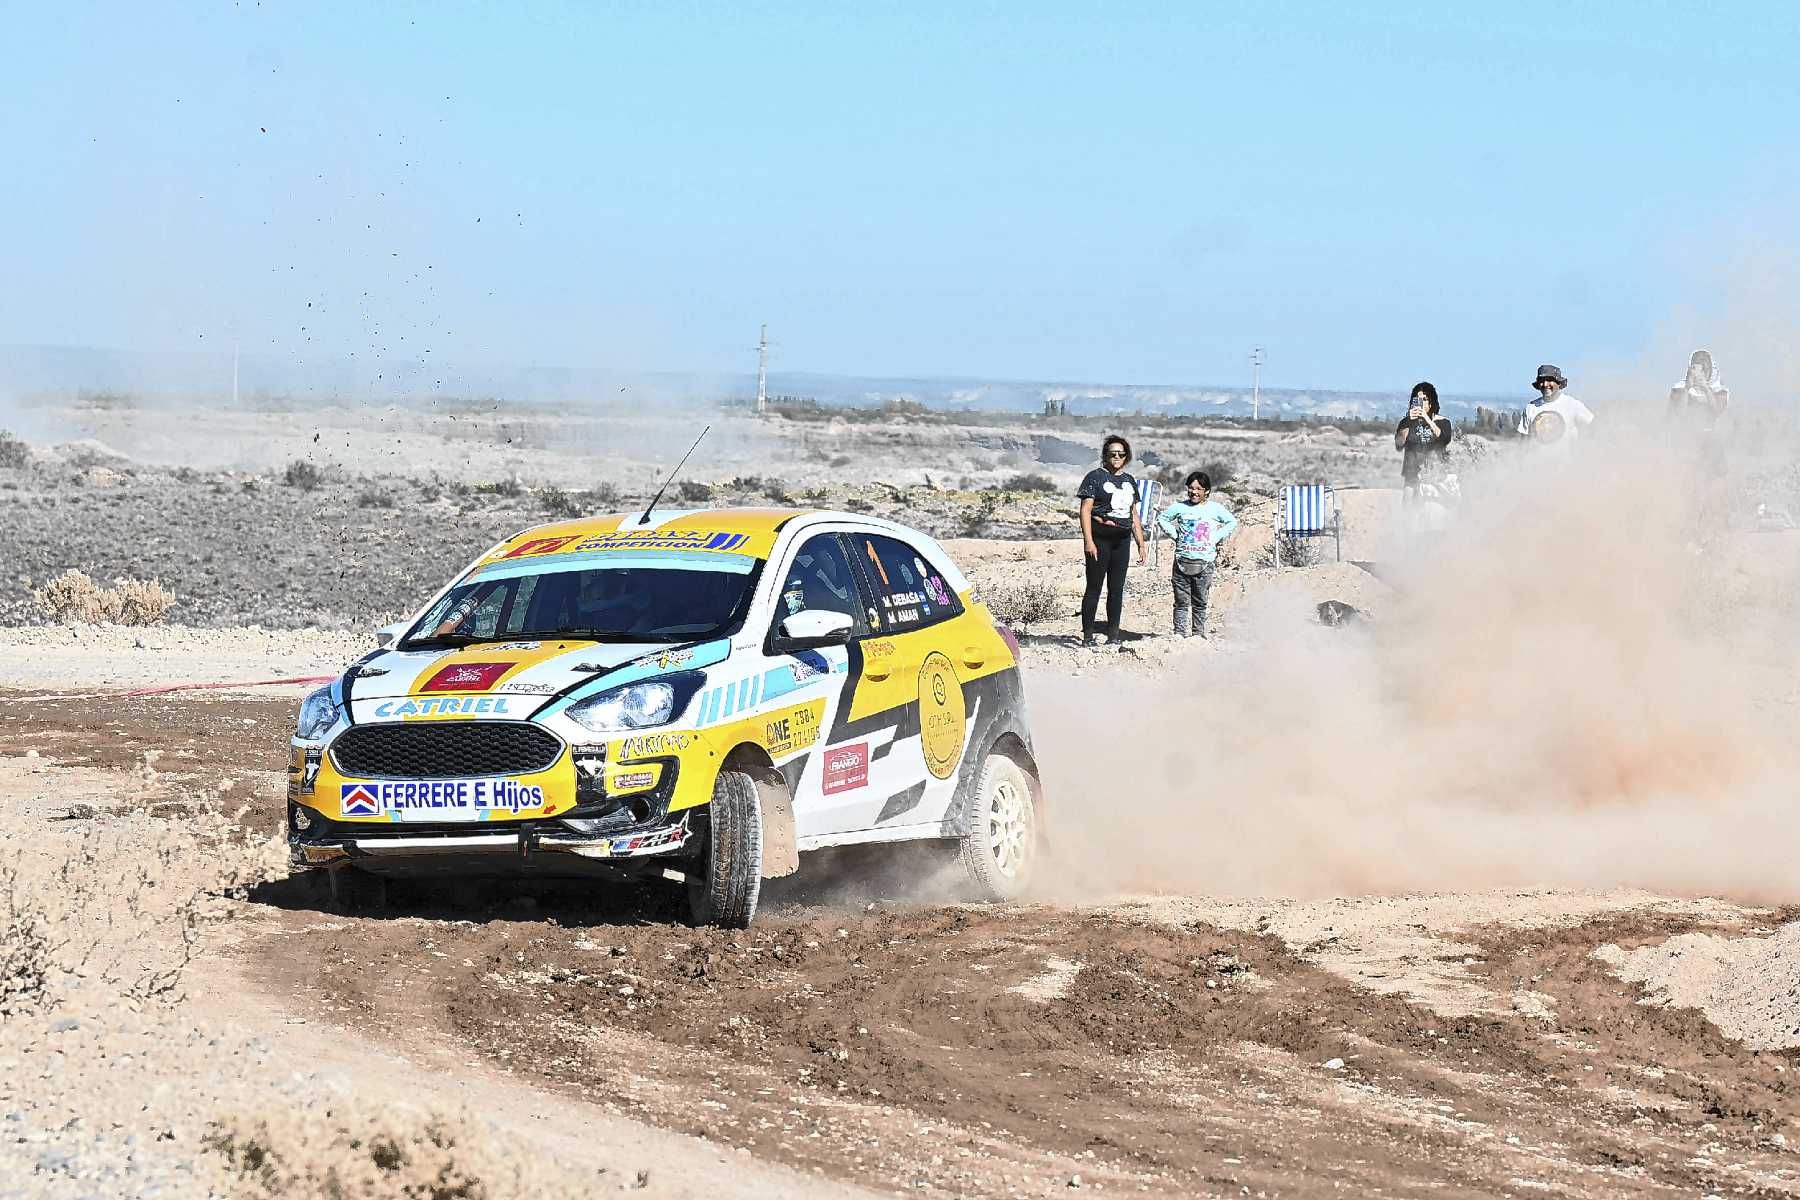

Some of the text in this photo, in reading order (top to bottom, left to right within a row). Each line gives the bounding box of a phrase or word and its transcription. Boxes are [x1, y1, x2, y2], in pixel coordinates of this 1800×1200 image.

[866, 540, 889, 585] 1
[374, 698, 509, 717] CATRIEL
[382, 781, 542, 813] FERRERE E Hijos
